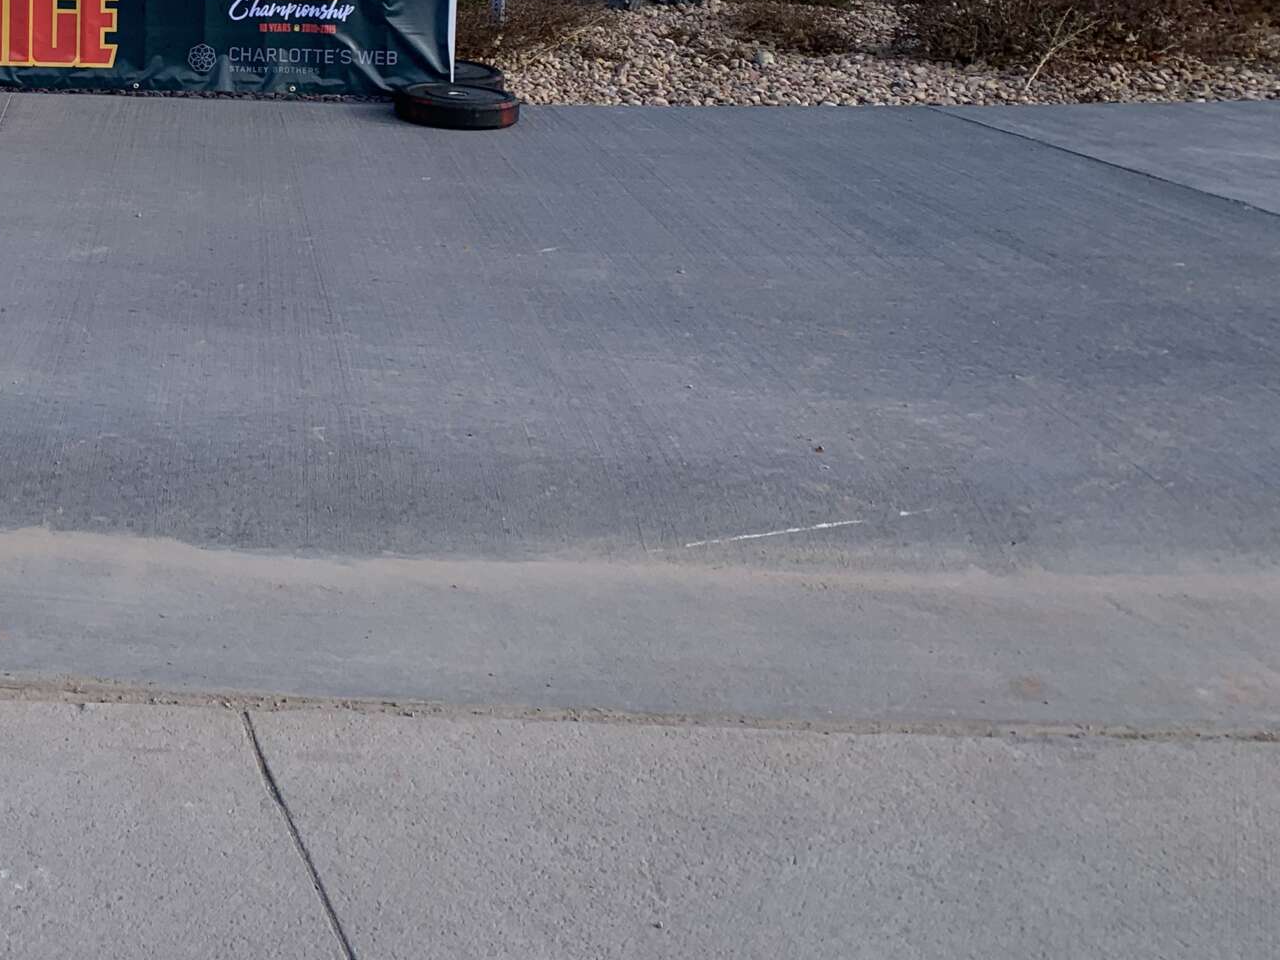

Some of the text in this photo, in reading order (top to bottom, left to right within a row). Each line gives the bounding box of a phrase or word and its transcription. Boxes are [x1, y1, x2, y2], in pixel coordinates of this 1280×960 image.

[268, 23, 292, 32] YEARS
[228, 46, 398, 66] CHARLOTTE'S WEB
[228, 65, 321, 75] STANLEY BROTHERS
